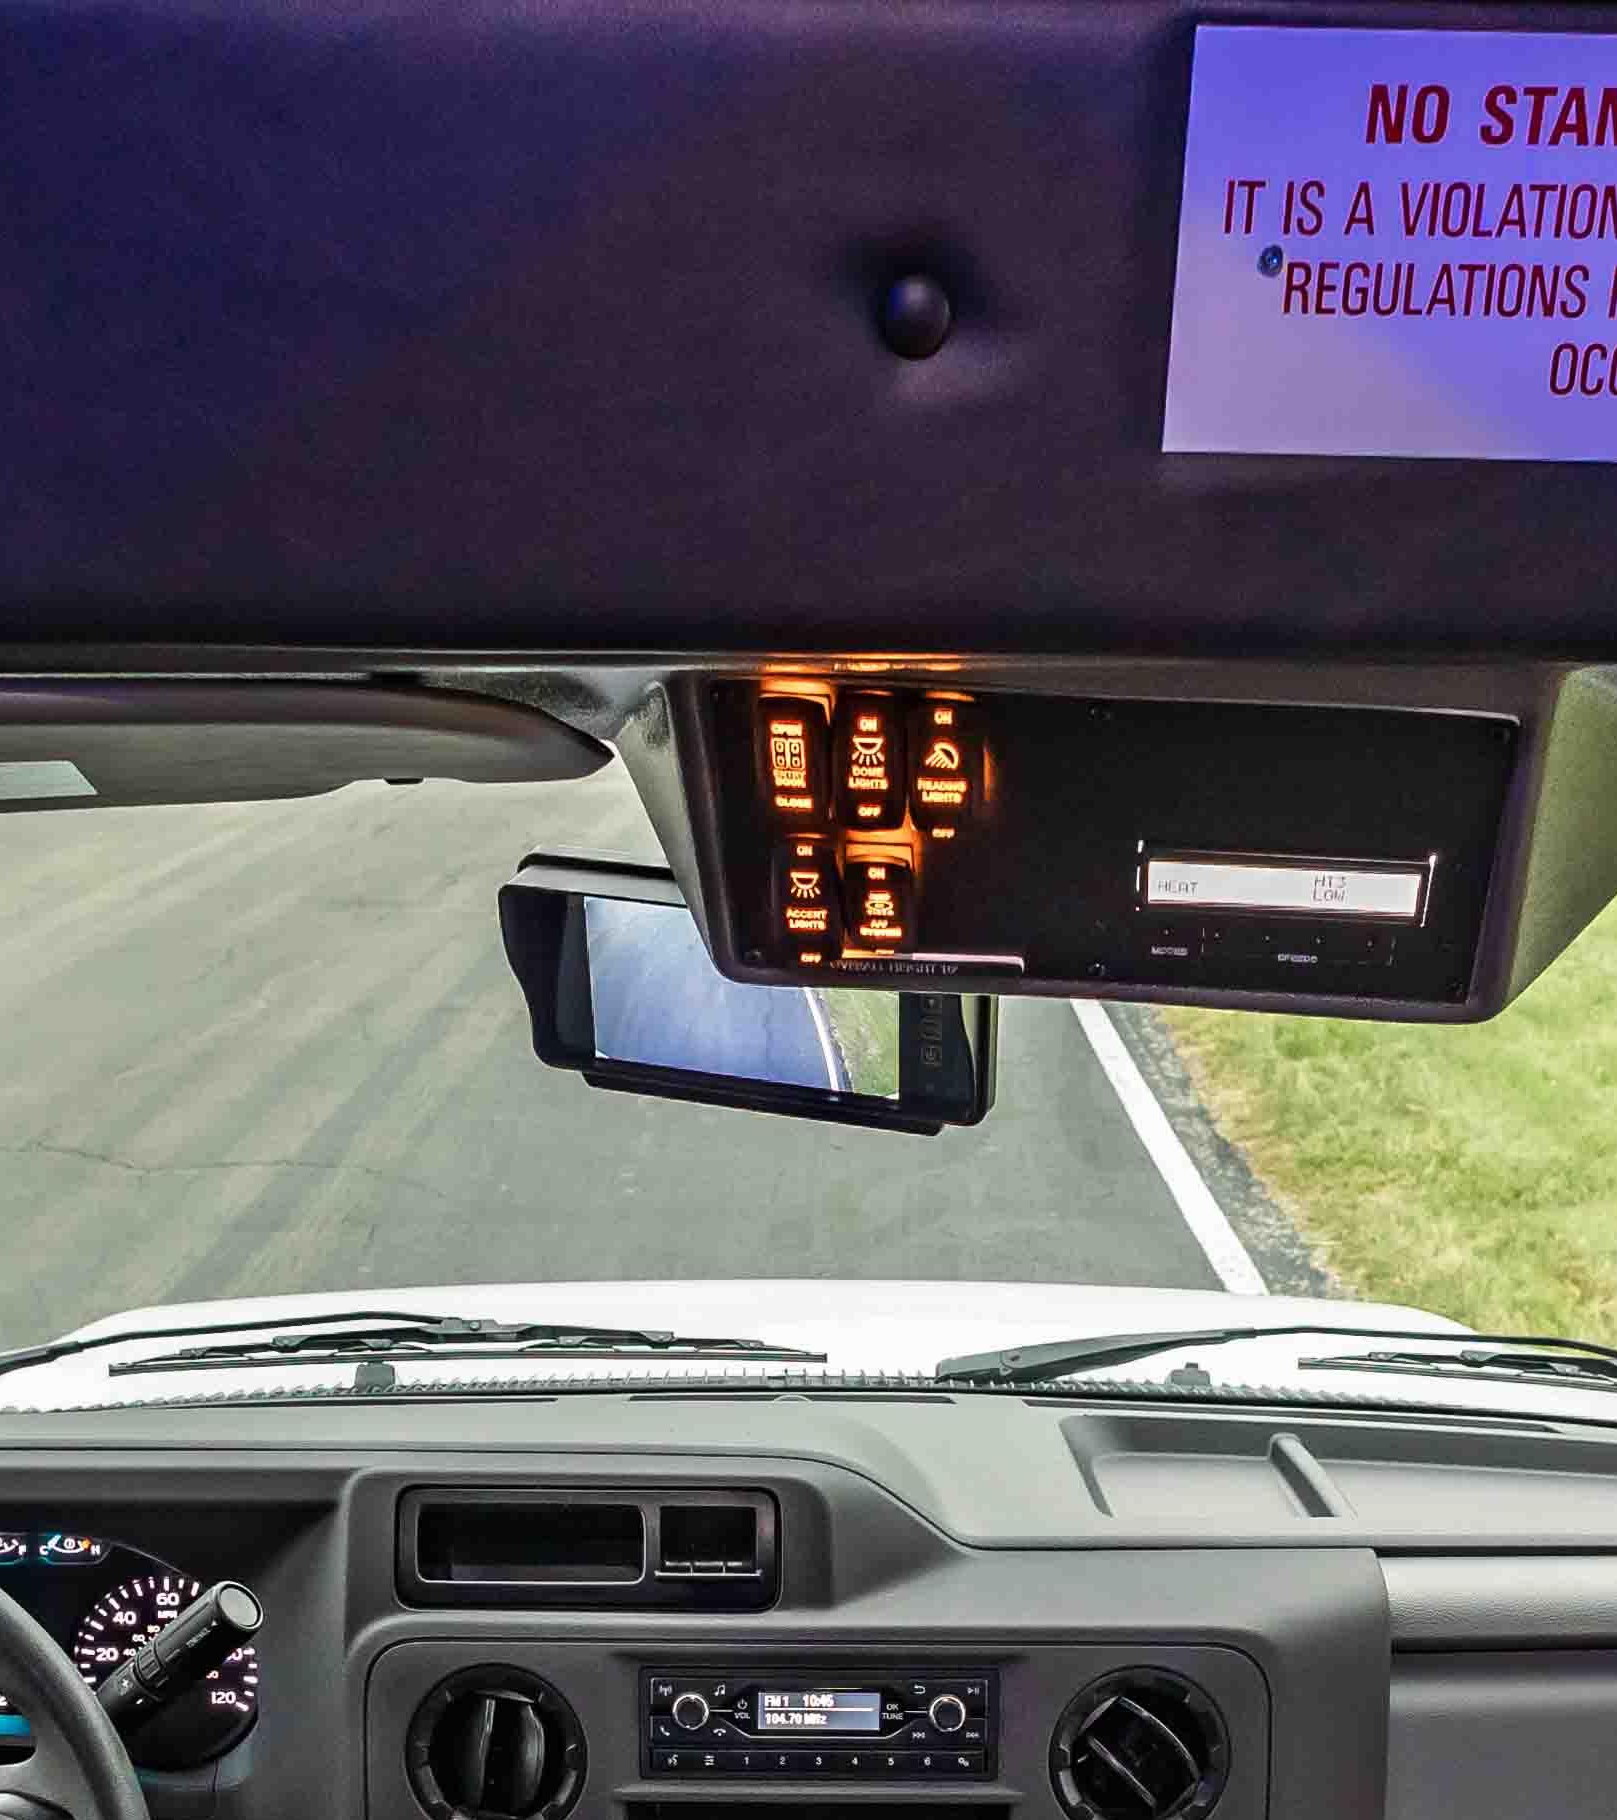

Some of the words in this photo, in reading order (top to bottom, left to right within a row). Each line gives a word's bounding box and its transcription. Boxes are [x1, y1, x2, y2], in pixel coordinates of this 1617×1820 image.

[1365, 83, 1450, 145] NO
[1223, 180, 1266, 234] IT
[1282, 180, 1326, 236] IS
[1344, 181, 1375, 236] A
[1282, 261, 1590, 319] REGULATIONS
[934, 710, 953, 724] ON
[770, 722, 803, 736] OPEN
[859, 718, 878, 732] ON
[848, 777, 888, 790] LIGHTS
[858, 805, 881, 817] OFF
[932, 828, 955, 839] OFF
[796, 845, 813, 856] ON
[867, 867, 886, 880] ON
[1158, 879, 1198, 895] HEAT
[786, 909, 828, 920] ACCENT
[789, 919, 826, 930] LIGHTS
[156, 1593, 180, 1606] 60
[112, 1611, 137, 1625] 40
[95, 1648, 119, 1661] 20
[211, 1691, 237, 1704] 120
[886, 1703, 899, 1711] OK
[765, 1712, 802, 1725] 104.70
[882, 1712, 904, 1720] TUNE
